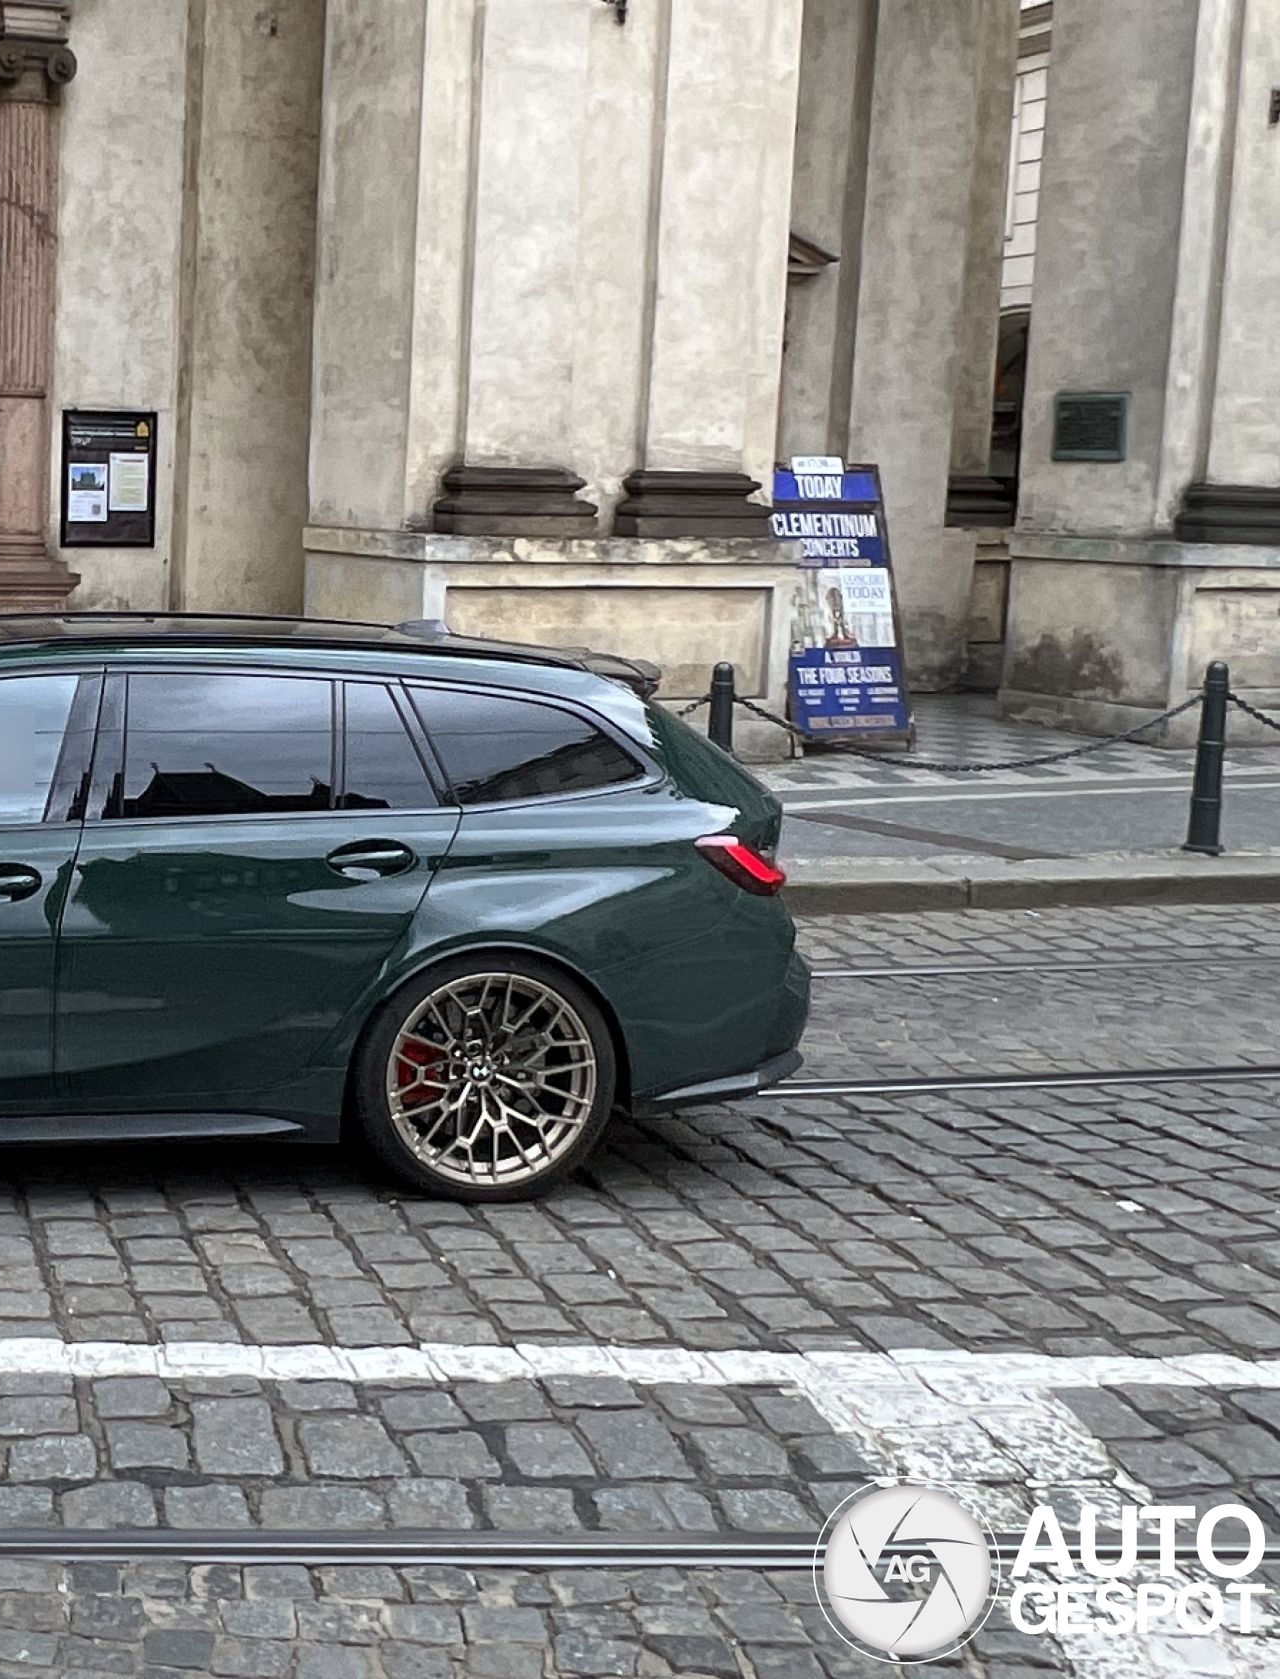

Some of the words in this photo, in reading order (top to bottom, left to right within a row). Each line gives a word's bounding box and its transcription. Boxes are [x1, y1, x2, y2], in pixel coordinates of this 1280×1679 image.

[794, 474, 842, 499] TODAY
[772, 513, 878, 537] CLEMENTINUM
[845, 586, 886, 600] TODAY
[797, 667, 819, 685] THE
[819, 667, 848, 685] FOUR
[847, 666, 893, 684] SEASONS
